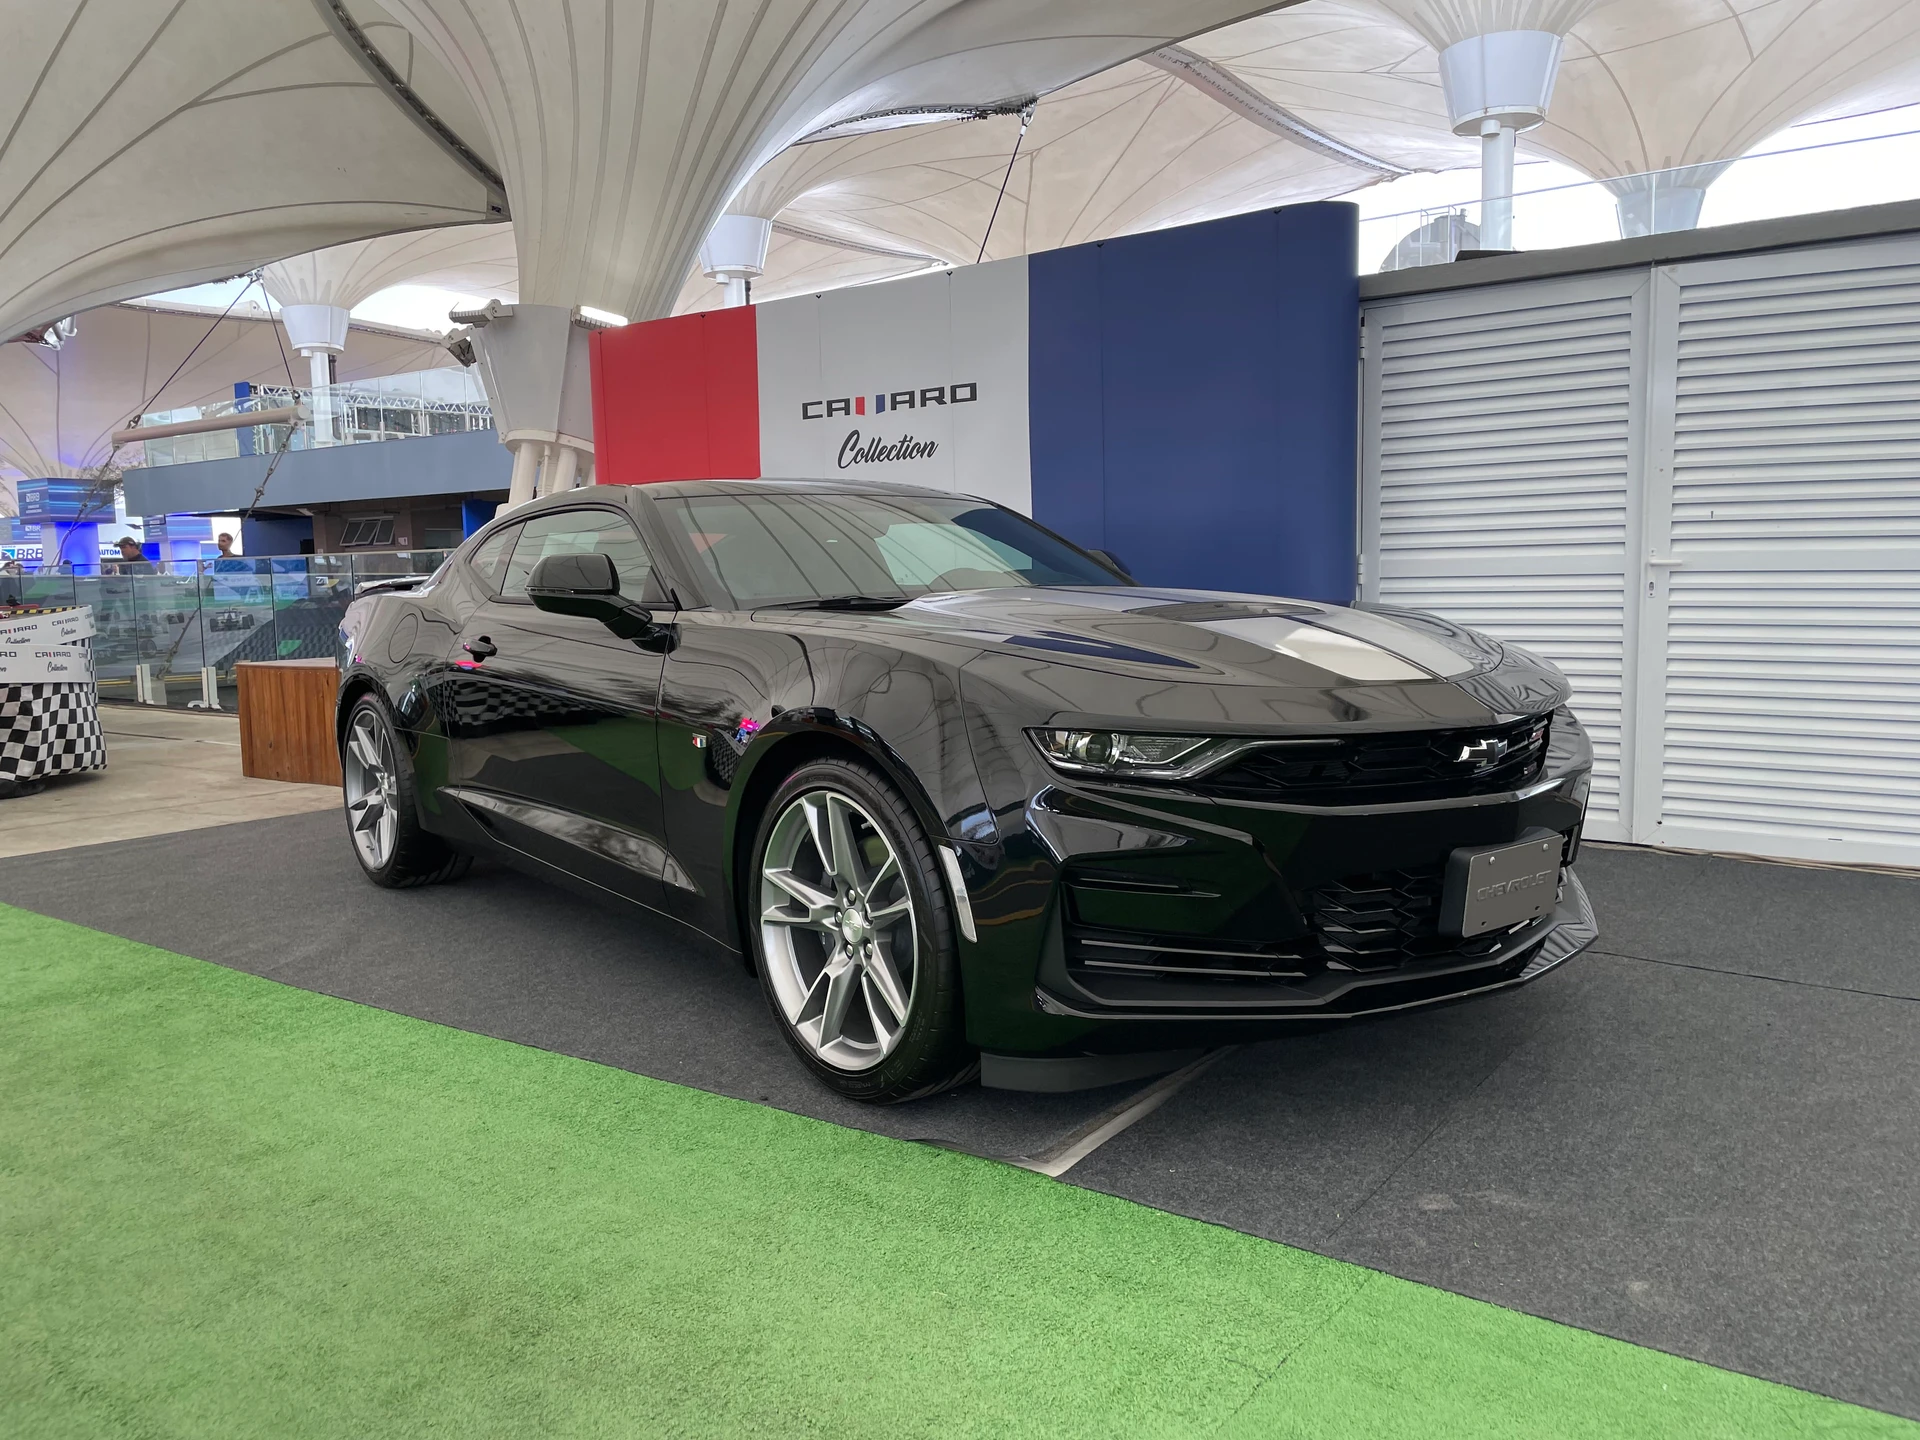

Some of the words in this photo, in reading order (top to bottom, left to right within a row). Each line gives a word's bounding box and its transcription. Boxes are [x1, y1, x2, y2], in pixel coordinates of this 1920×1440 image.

[838, 429, 938, 469] Collection
[17, 548, 43, 559] BRB
[1477, 870, 1552, 901] CHEVROLET
